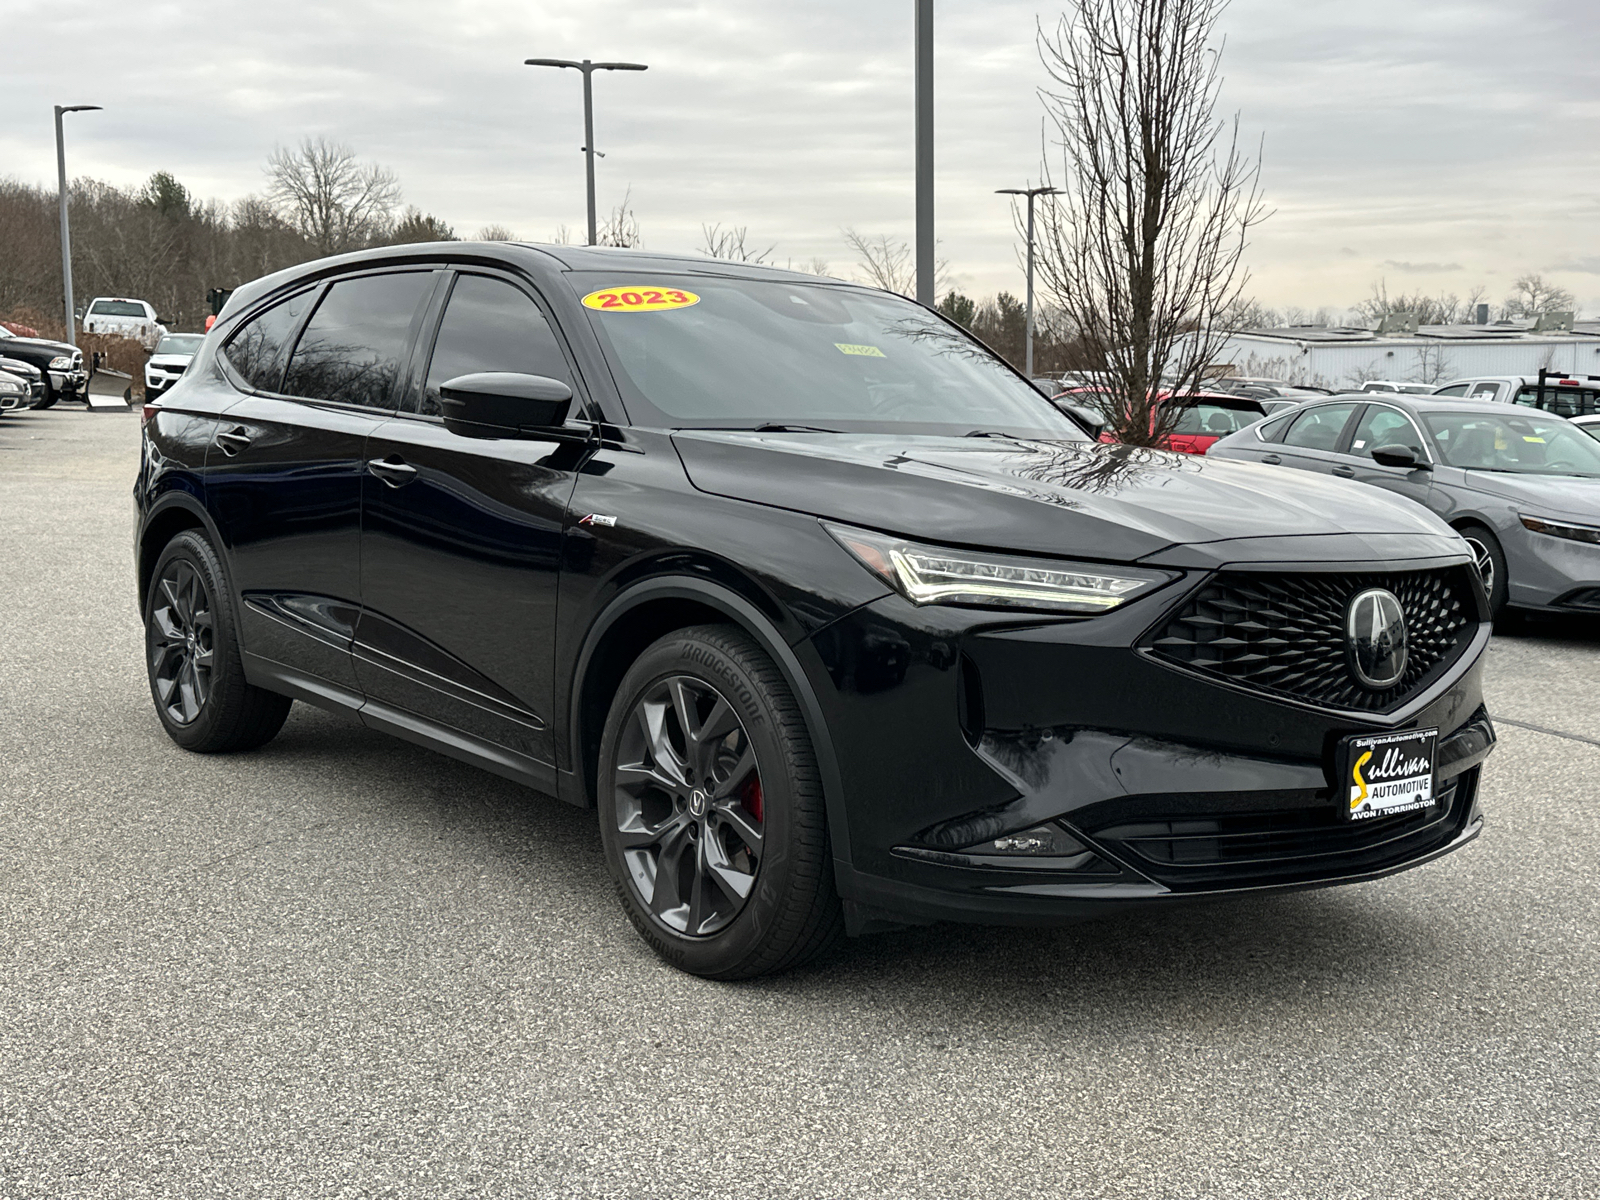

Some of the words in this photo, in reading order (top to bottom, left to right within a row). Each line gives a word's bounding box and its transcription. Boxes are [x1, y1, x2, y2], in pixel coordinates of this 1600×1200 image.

[597, 290, 690, 308] 2023
[681, 643, 765, 728] BRIDGESTONE
[1356, 730, 1438, 747] SullivanAutomotive.com
[1350, 747, 1430, 809] Sullivan
[1372, 777, 1429, 799] AUTOMOTIVE
[1351, 810, 1376, 820] AVON
[1383, 799, 1436, 815] TORRINGTON
